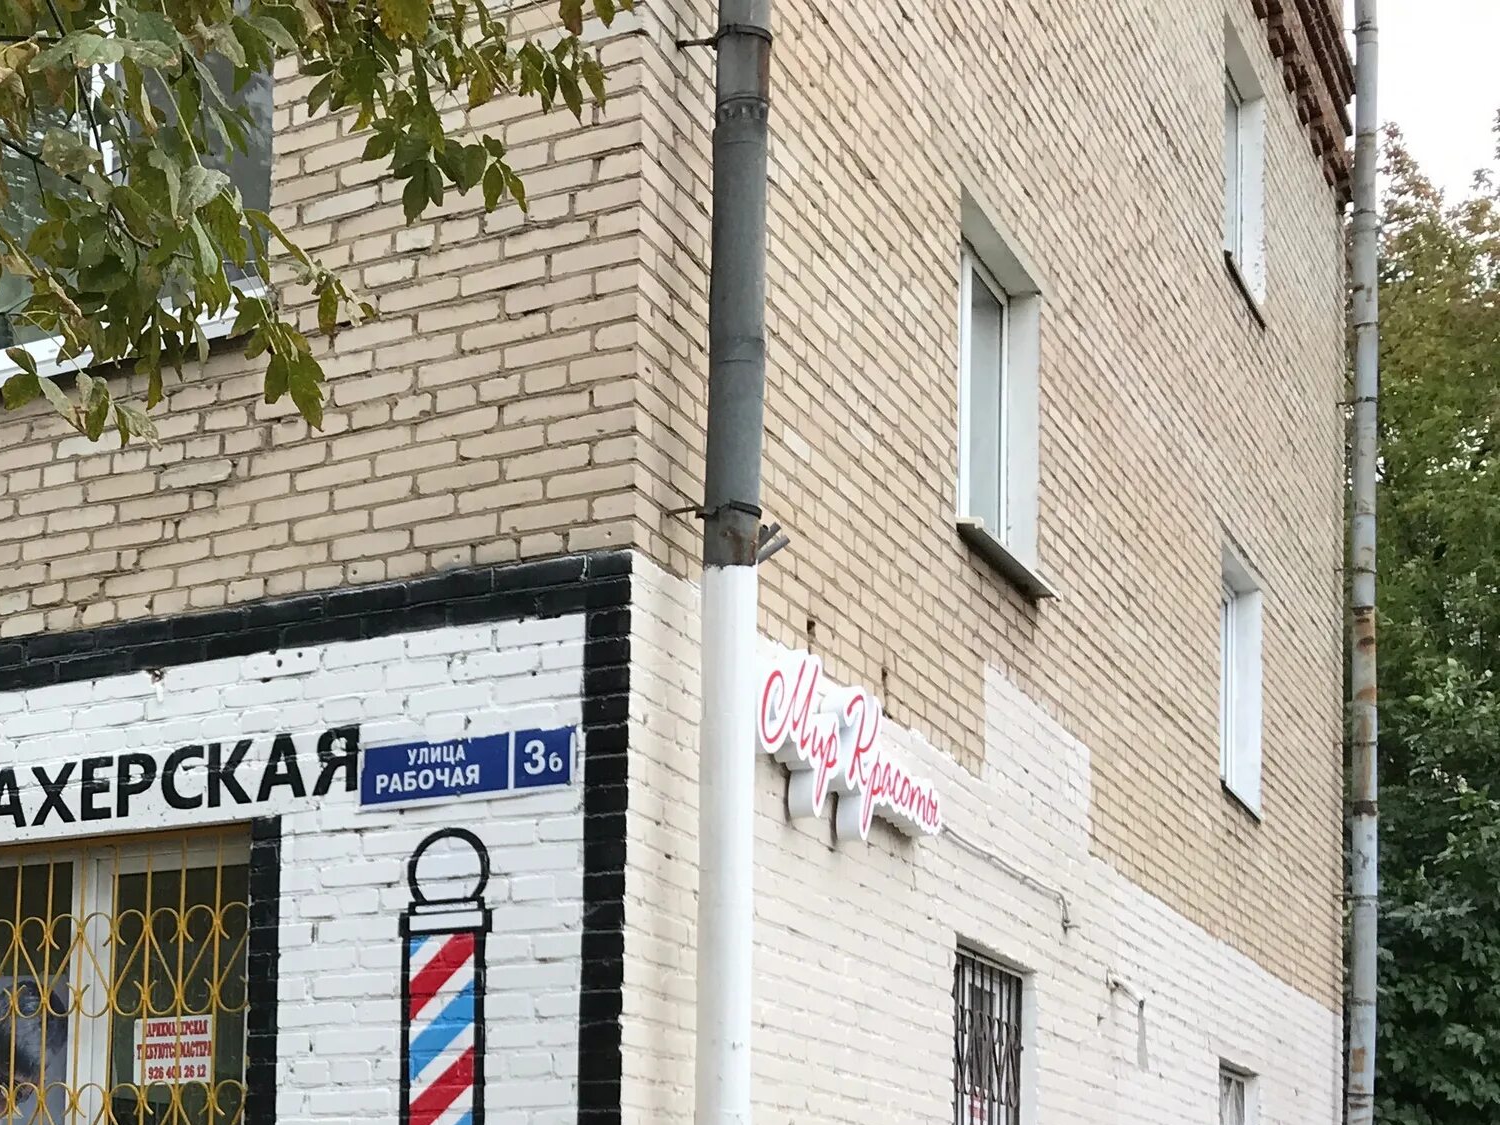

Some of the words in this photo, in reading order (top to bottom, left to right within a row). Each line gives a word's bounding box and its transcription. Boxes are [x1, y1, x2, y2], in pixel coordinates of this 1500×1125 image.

[406, 744, 466, 766] УЛИЦА
[761, 659, 838, 806] Мир
[846, 694, 940, 833] Красоты
[375, 764, 481, 795] РАБОЧАЯ
[148, 1066, 164, 1080] 926
[184, 1064, 195, 1078] 26
